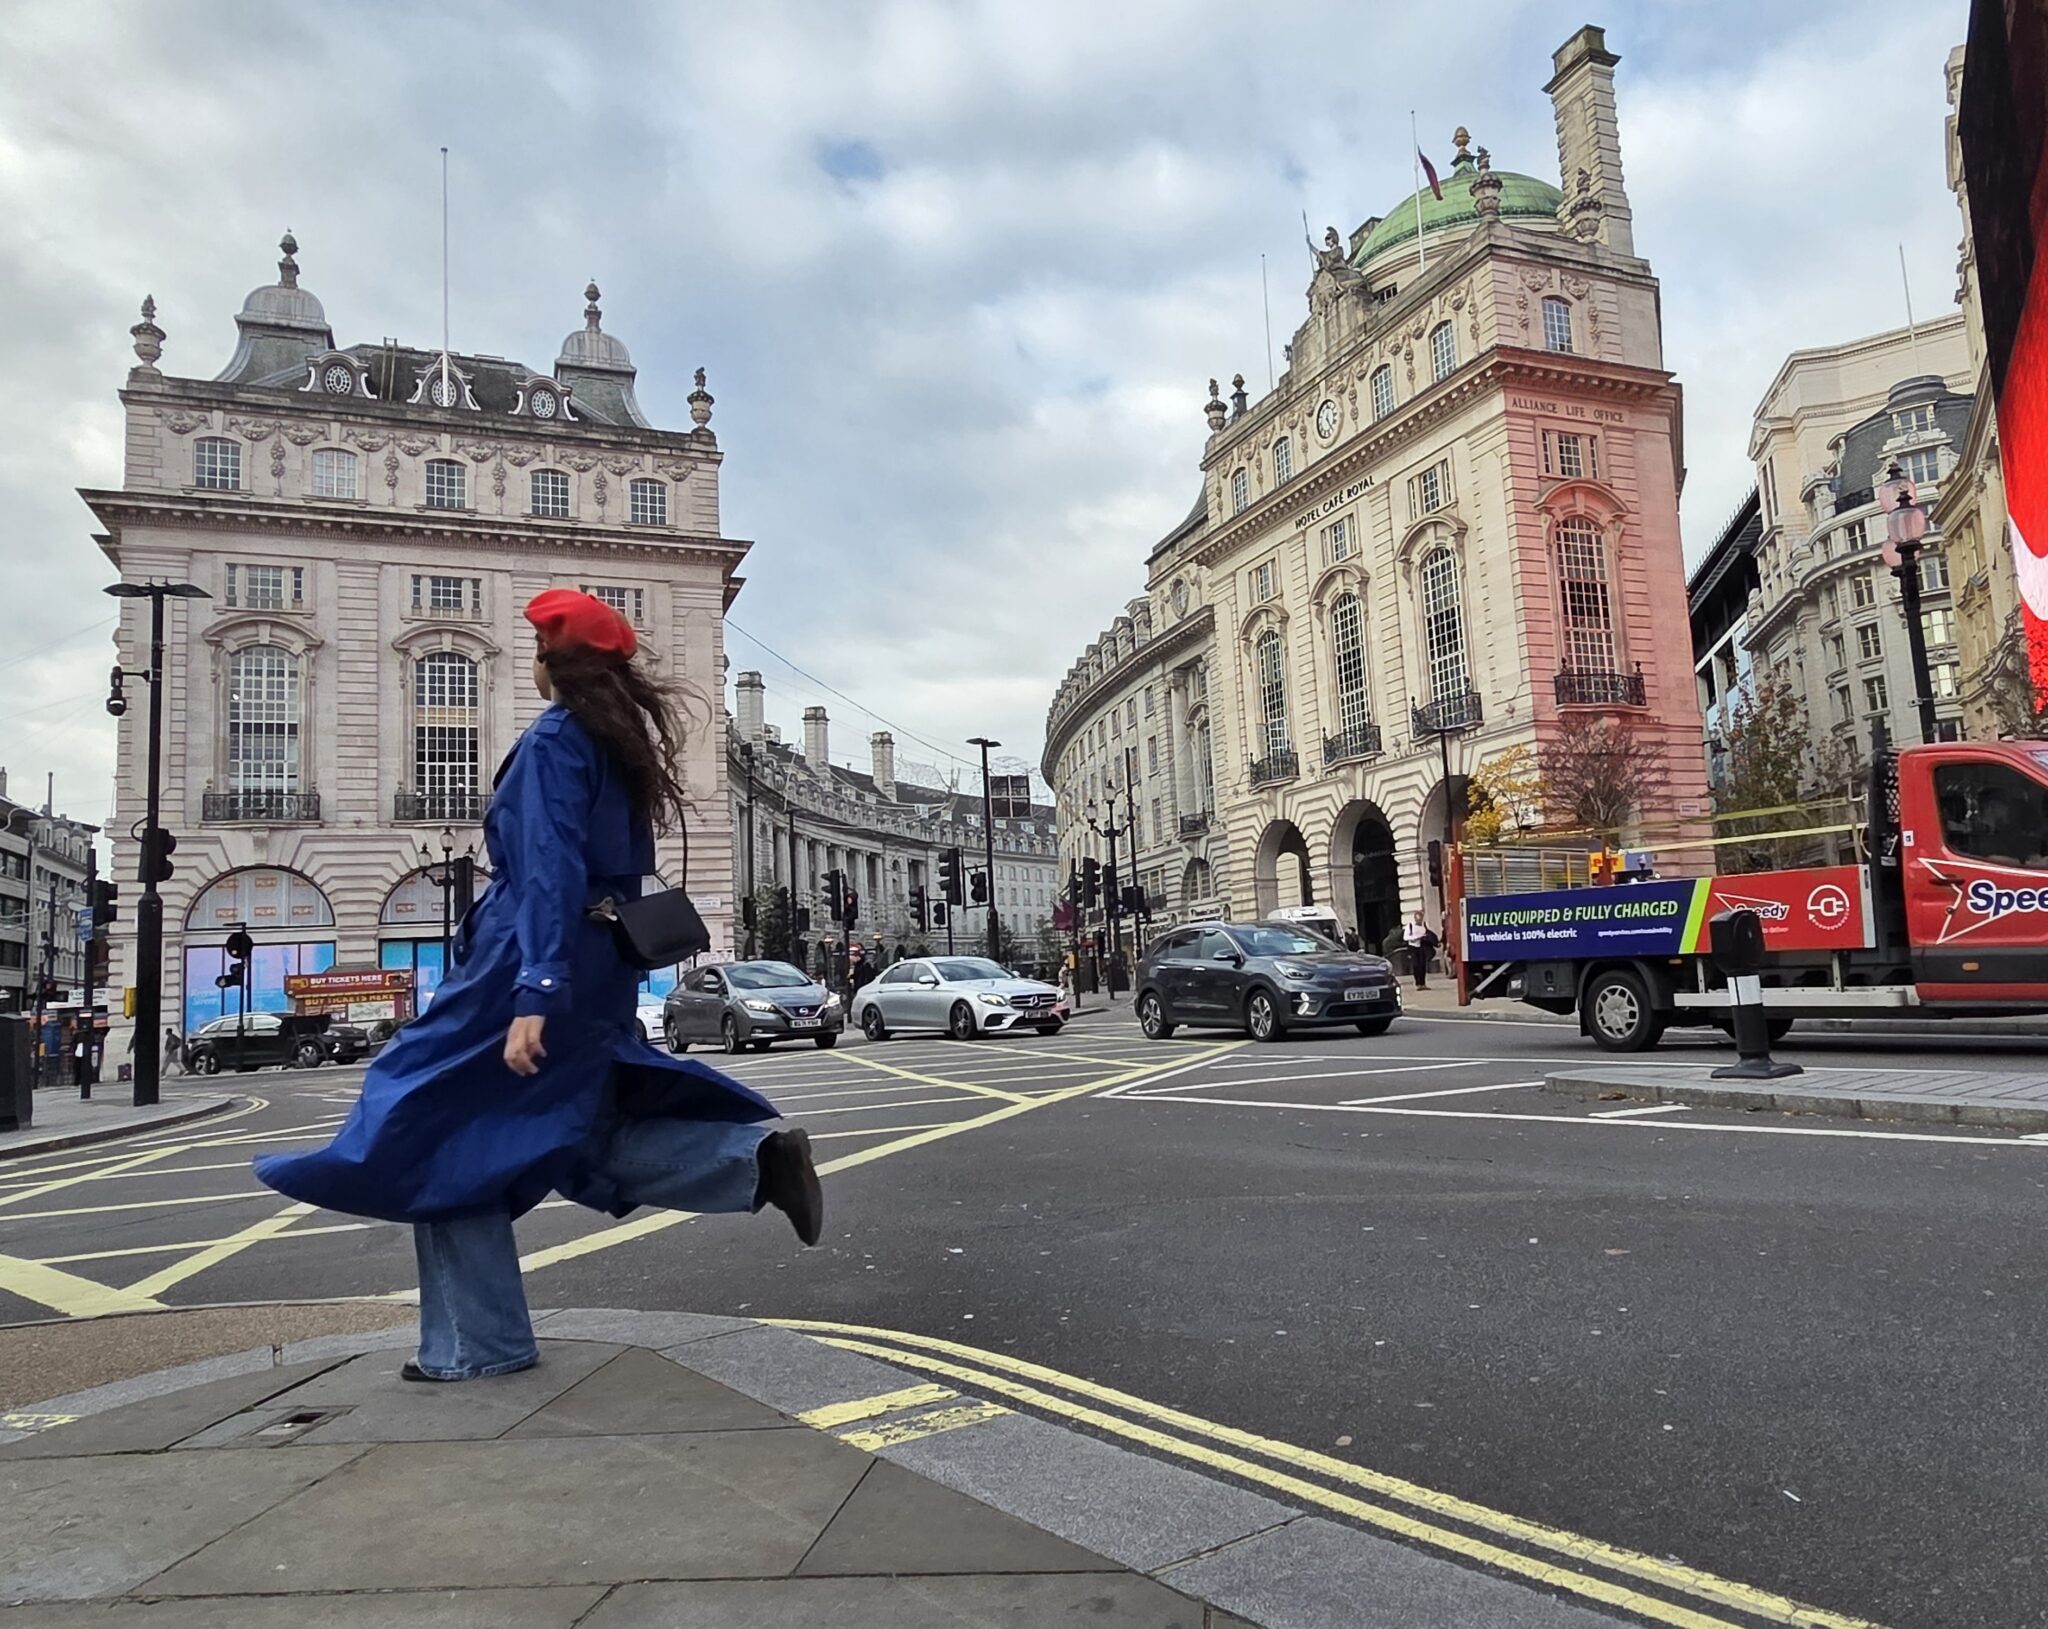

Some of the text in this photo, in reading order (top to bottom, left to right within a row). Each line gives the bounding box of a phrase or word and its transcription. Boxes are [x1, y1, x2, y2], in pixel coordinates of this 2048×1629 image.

[1512, 397, 1625, 423] ALLIANCE LIFE OFFICE
[1295, 475, 1375, 529] HOTEL CAFÉ ROYAL
[1470, 900, 1678, 927] FULLY EQUIPPED & FULLY CHARGED
[1735, 903, 1789, 921] eedy
[1469, 927, 1578, 942] This vehicle is 100% electric
[328, 975, 360, 984] TICKETS
[361, 974, 382, 983] HERE
